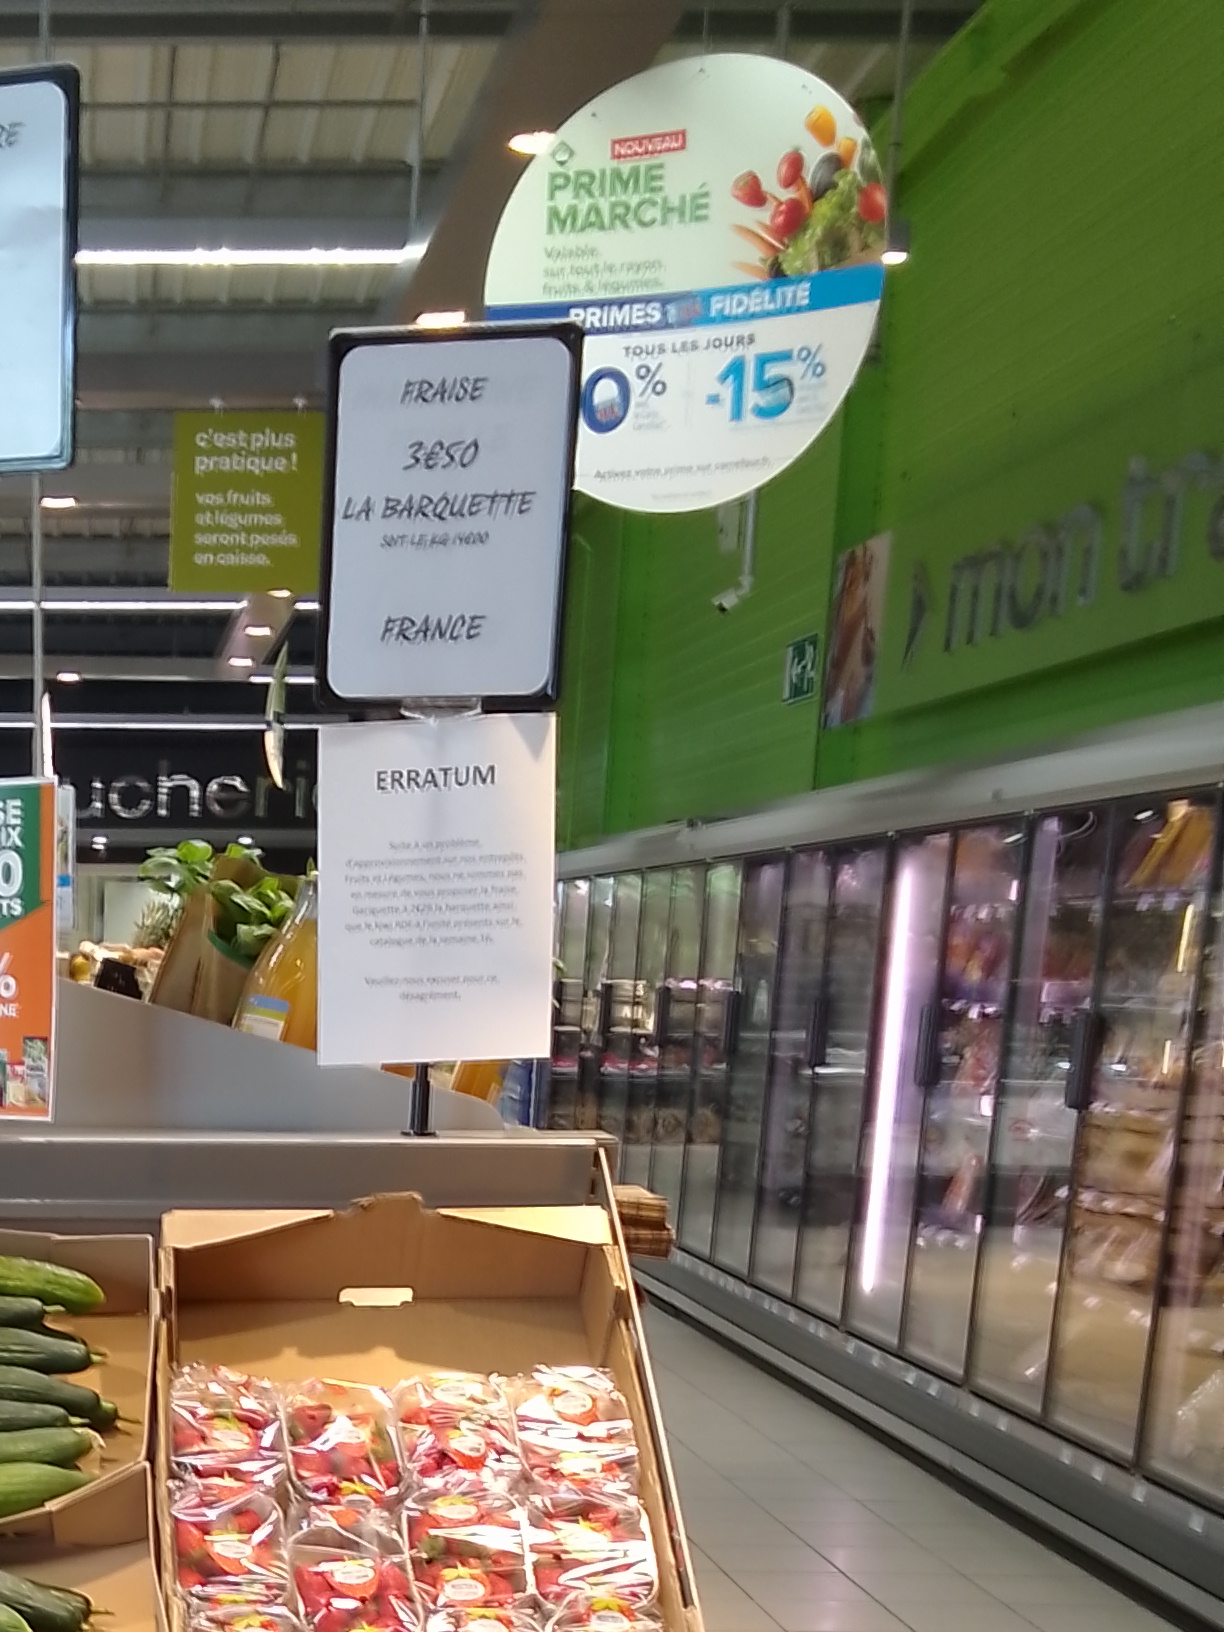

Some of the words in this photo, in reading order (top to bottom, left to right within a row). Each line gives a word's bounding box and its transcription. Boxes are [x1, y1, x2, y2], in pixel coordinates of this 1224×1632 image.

[614, 133, 683, 156] NOUVEAU
[547, 163, 664, 201] PRIME
[546, 182, 710, 235] MARCHÉ
[570, 302, 661, 329] PRIMES
[708, 281, 811, 318] FIDÉLITÉ
[623, 342, 666, 357] TOUS
[671, 340, 699, 354] LES
[704, 333, 756, 351] JOURS
[400, 377, 488, 404] FRAISE
[705, 342, 826, 422] -15%
[195, 428, 248, 449] c'est
[250, 428, 296, 452] plus
[402, 438, 480, 471] 3€50
[194, 450, 288, 476] pratique
[226, 490, 272, 505] fruits
[342, 496, 373, 522] LA
[381, 490, 536, 520] BARQUETTE
[215, 510, 282, 528] légumes
[944, 502, 1102, 653] mon
[381, 614, 486, 643] FRANCE
[376, 763, 496, 792] ERRATUM
